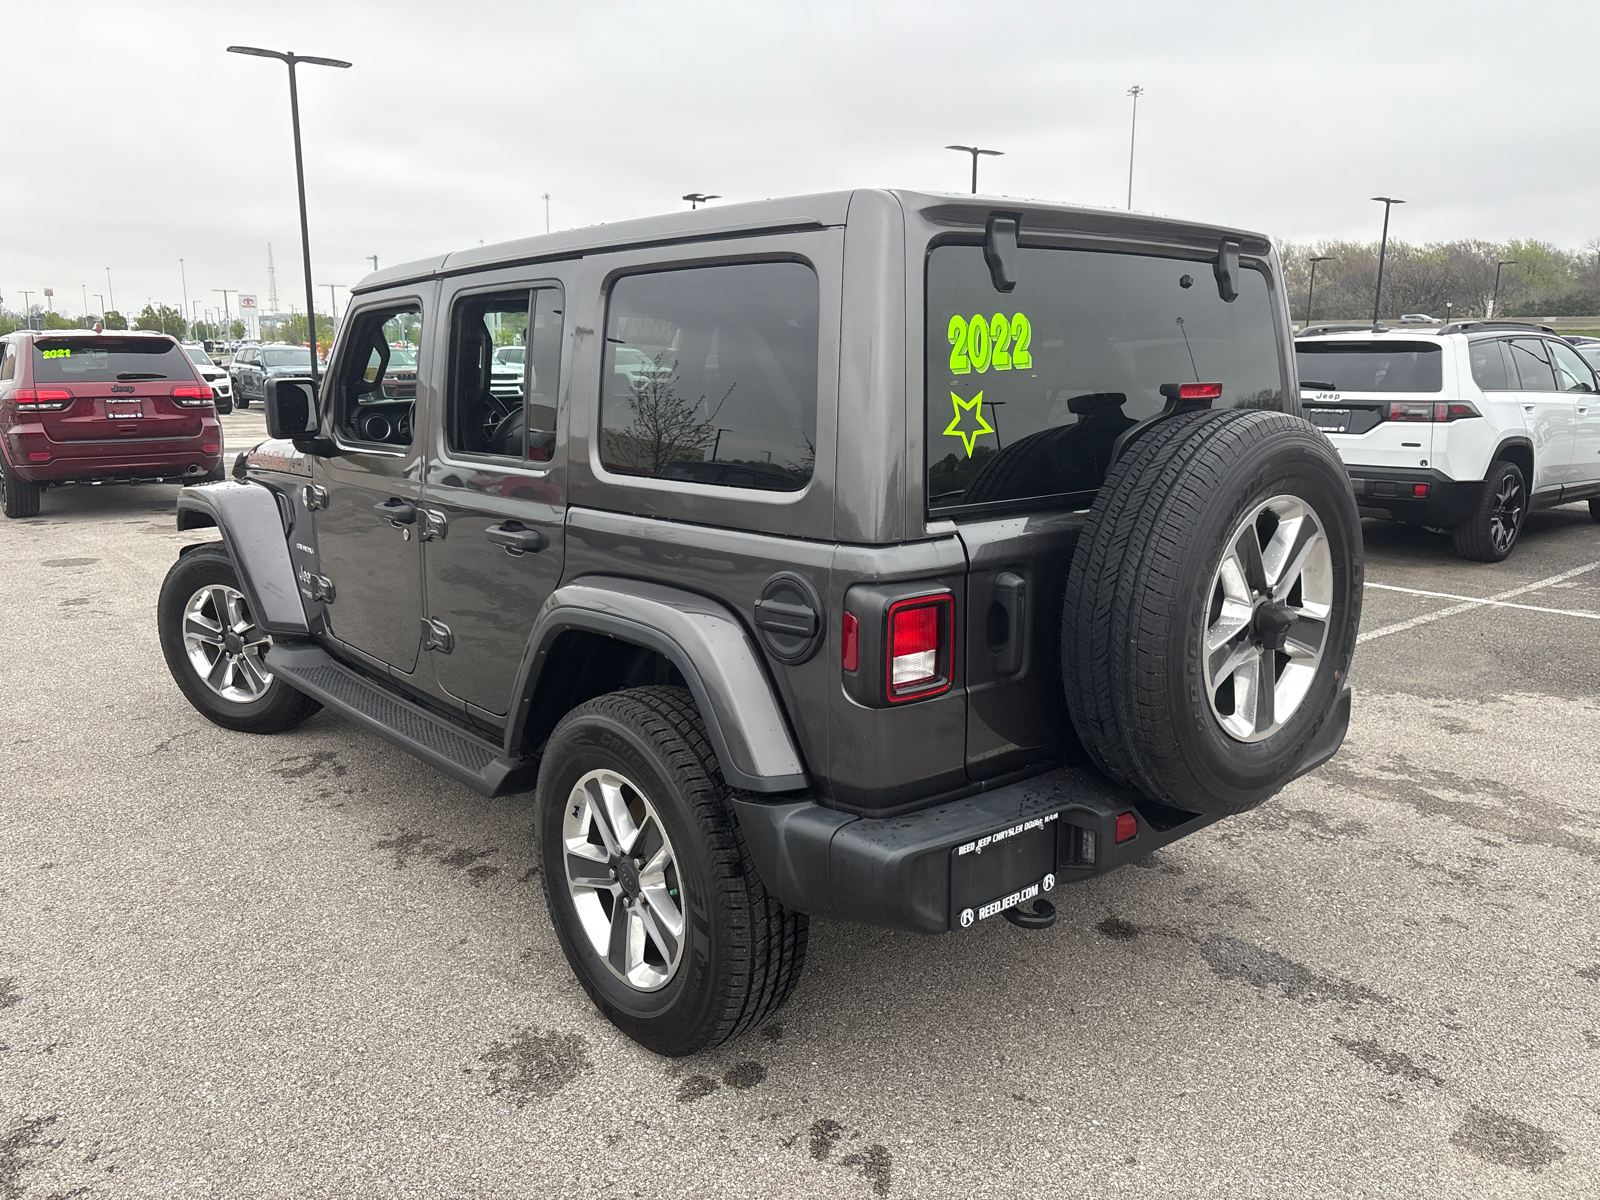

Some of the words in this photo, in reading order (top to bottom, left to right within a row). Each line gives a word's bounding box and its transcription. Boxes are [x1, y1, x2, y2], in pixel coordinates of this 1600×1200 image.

[42, 349, 71, 359] 2021
[948, 312, 1033, 375] 2022
[111, 385, 136, 393] Jeep
[1316, 392, 1341, 400] Jeep
[958, 841, 976, 856] REED
[977, 835, 992, 848] JEEP
[992, 823, 1024, 843] CHRYSLER
[1023, 818, 1044, 831] DODGE
[1044, 812, 1059, 823] RAM
[978, 884, 1039, 921] REEDJEEP.COM
